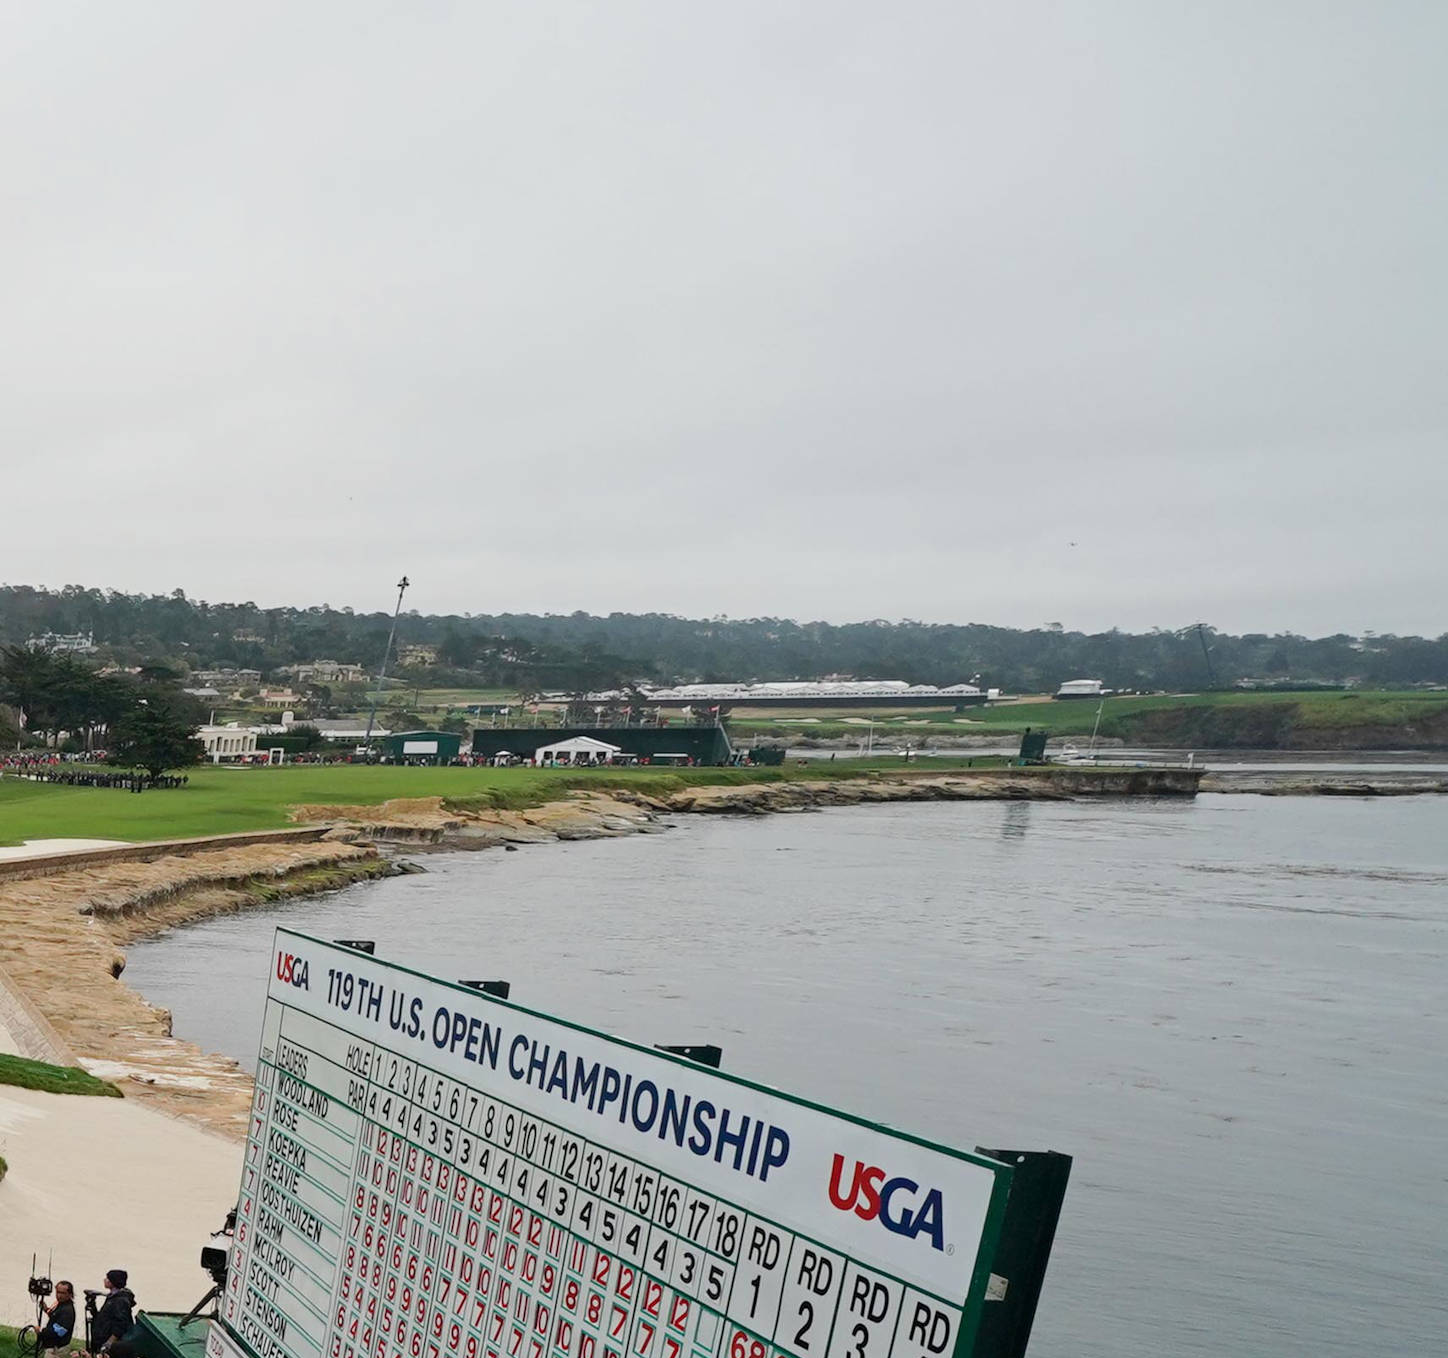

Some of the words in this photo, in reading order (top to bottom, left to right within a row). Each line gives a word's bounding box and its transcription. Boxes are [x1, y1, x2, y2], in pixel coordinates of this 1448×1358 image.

[276, 950, 308, 991] USGA
[277, 1073, 329, 1119] WOODLAND
[389, 989, 425, 1040] U.S.
[432, 1006, 501, 1070] OPEN
[508, 1034, 790, 1182] CHAMPIONSHIP
[268, 1127, 307, 1170] KOEPKA
[277, 1044, 308, 1081] LEADERS
[347, 1079, 364, 1111] PAR
[369, 1091, 377, 1114] 4
[382, 1097, 391, 1120] 4
[397, 1105, 406, 1128] 4
[413, 1113, 422, 1137] 4
[427, 1120, 437, 1144] 3
[443, 1127, 453, 1154] 5
[459, 1138, 470, 1164] 3
[478, 1148, 489, 1175] 4
[496, 1158, 508, 1184] 4
[516, 1168, 528, 1196] 4
[536, 1178, 548, 1206] 4
[554, 1186, 568, 1216] 3
[578, 1200, 593, 1230] 4
[601, 1209, 615, 1241] 5
[625, 1224, 641, 1255] 4
[652, 1239, 668, 1270] 4
[679, 1252, 695, 1284] 3
[705, 1264, 724, 1300] 5
[345, 1045, 370, 1075] HOLE
[375, 1053, 381, 1081] 1
[387, 1059, 397, 1088] 2
[402, 1065, 410, 1095] 3
[417, 1074, 427, 1103] 4
[432, 1080, 443, 1111] 5
[449, 1087, 459, 1120] 6
[467, 1096, 478, 1128] 7
[484, 1104, 495, 1138] 8
[503, 1113, 514, 1147] 9
[520, 1121, 536, 1159] 10
[541, 1132, 556, 1169] 11
[559, 1140, 578, 1180] 12
[584, 1151, 602, 1191] 13
[607, 1162, 627, 1203] 14
[632, 1173, 653, 1215] 15
[658, 1185, 679, 1228] 16
[686, 1199, 709, 1241] 17
[714, 1211, 738, 1257] 18
[257, 1207, 284, 1244] RAHM
[261, 1180, 322, 1243] OOSTHUIZEN
[272, 1100, 298, 1132] ROSE
[539, 1265, 554, 1293] 9
[564, 1281, 579, 1309] 8
[587, 1293, 602, 1323] 8
[611, 1306, 627, 1336] 7
[639, 1322, 653, 1353] 7
[828, 1153, 944, 1251] USGA
[253, 1233, 294, 1284] MCILROY
[264, 1154, 299, 1196] REAVIE
[352, 1216, 360, 1234] 7
[363, 1224, 373, 1247] 6
[376, 1234, 386, 1257] 6
[392, 1245, 402, 1268] 6
[407, 1255, 418, 1279] 6
[421, 1265, 432, 1290] 6
[440, 1278, 451, 1301] 7
[455, 1288, 468, 1314] 7
[474, 1300, 486, 1327] 7
[493, 1314, 504, 1340] 7
[511, 1328, 523, 1355] 7
[747, 1225, 780, 1270] RD
[797, 1248, 832, 1296] RD
[249, 1260, 279, 1302] SCOTT
[749, 1274, 761, 1318] 1
[849, 1273, 889, 1323] RD
[245, 1285, 287, 1341] STENSON
[793, 1300, 813, 1350] 2
[908, 1301, 950, 1354] RD
